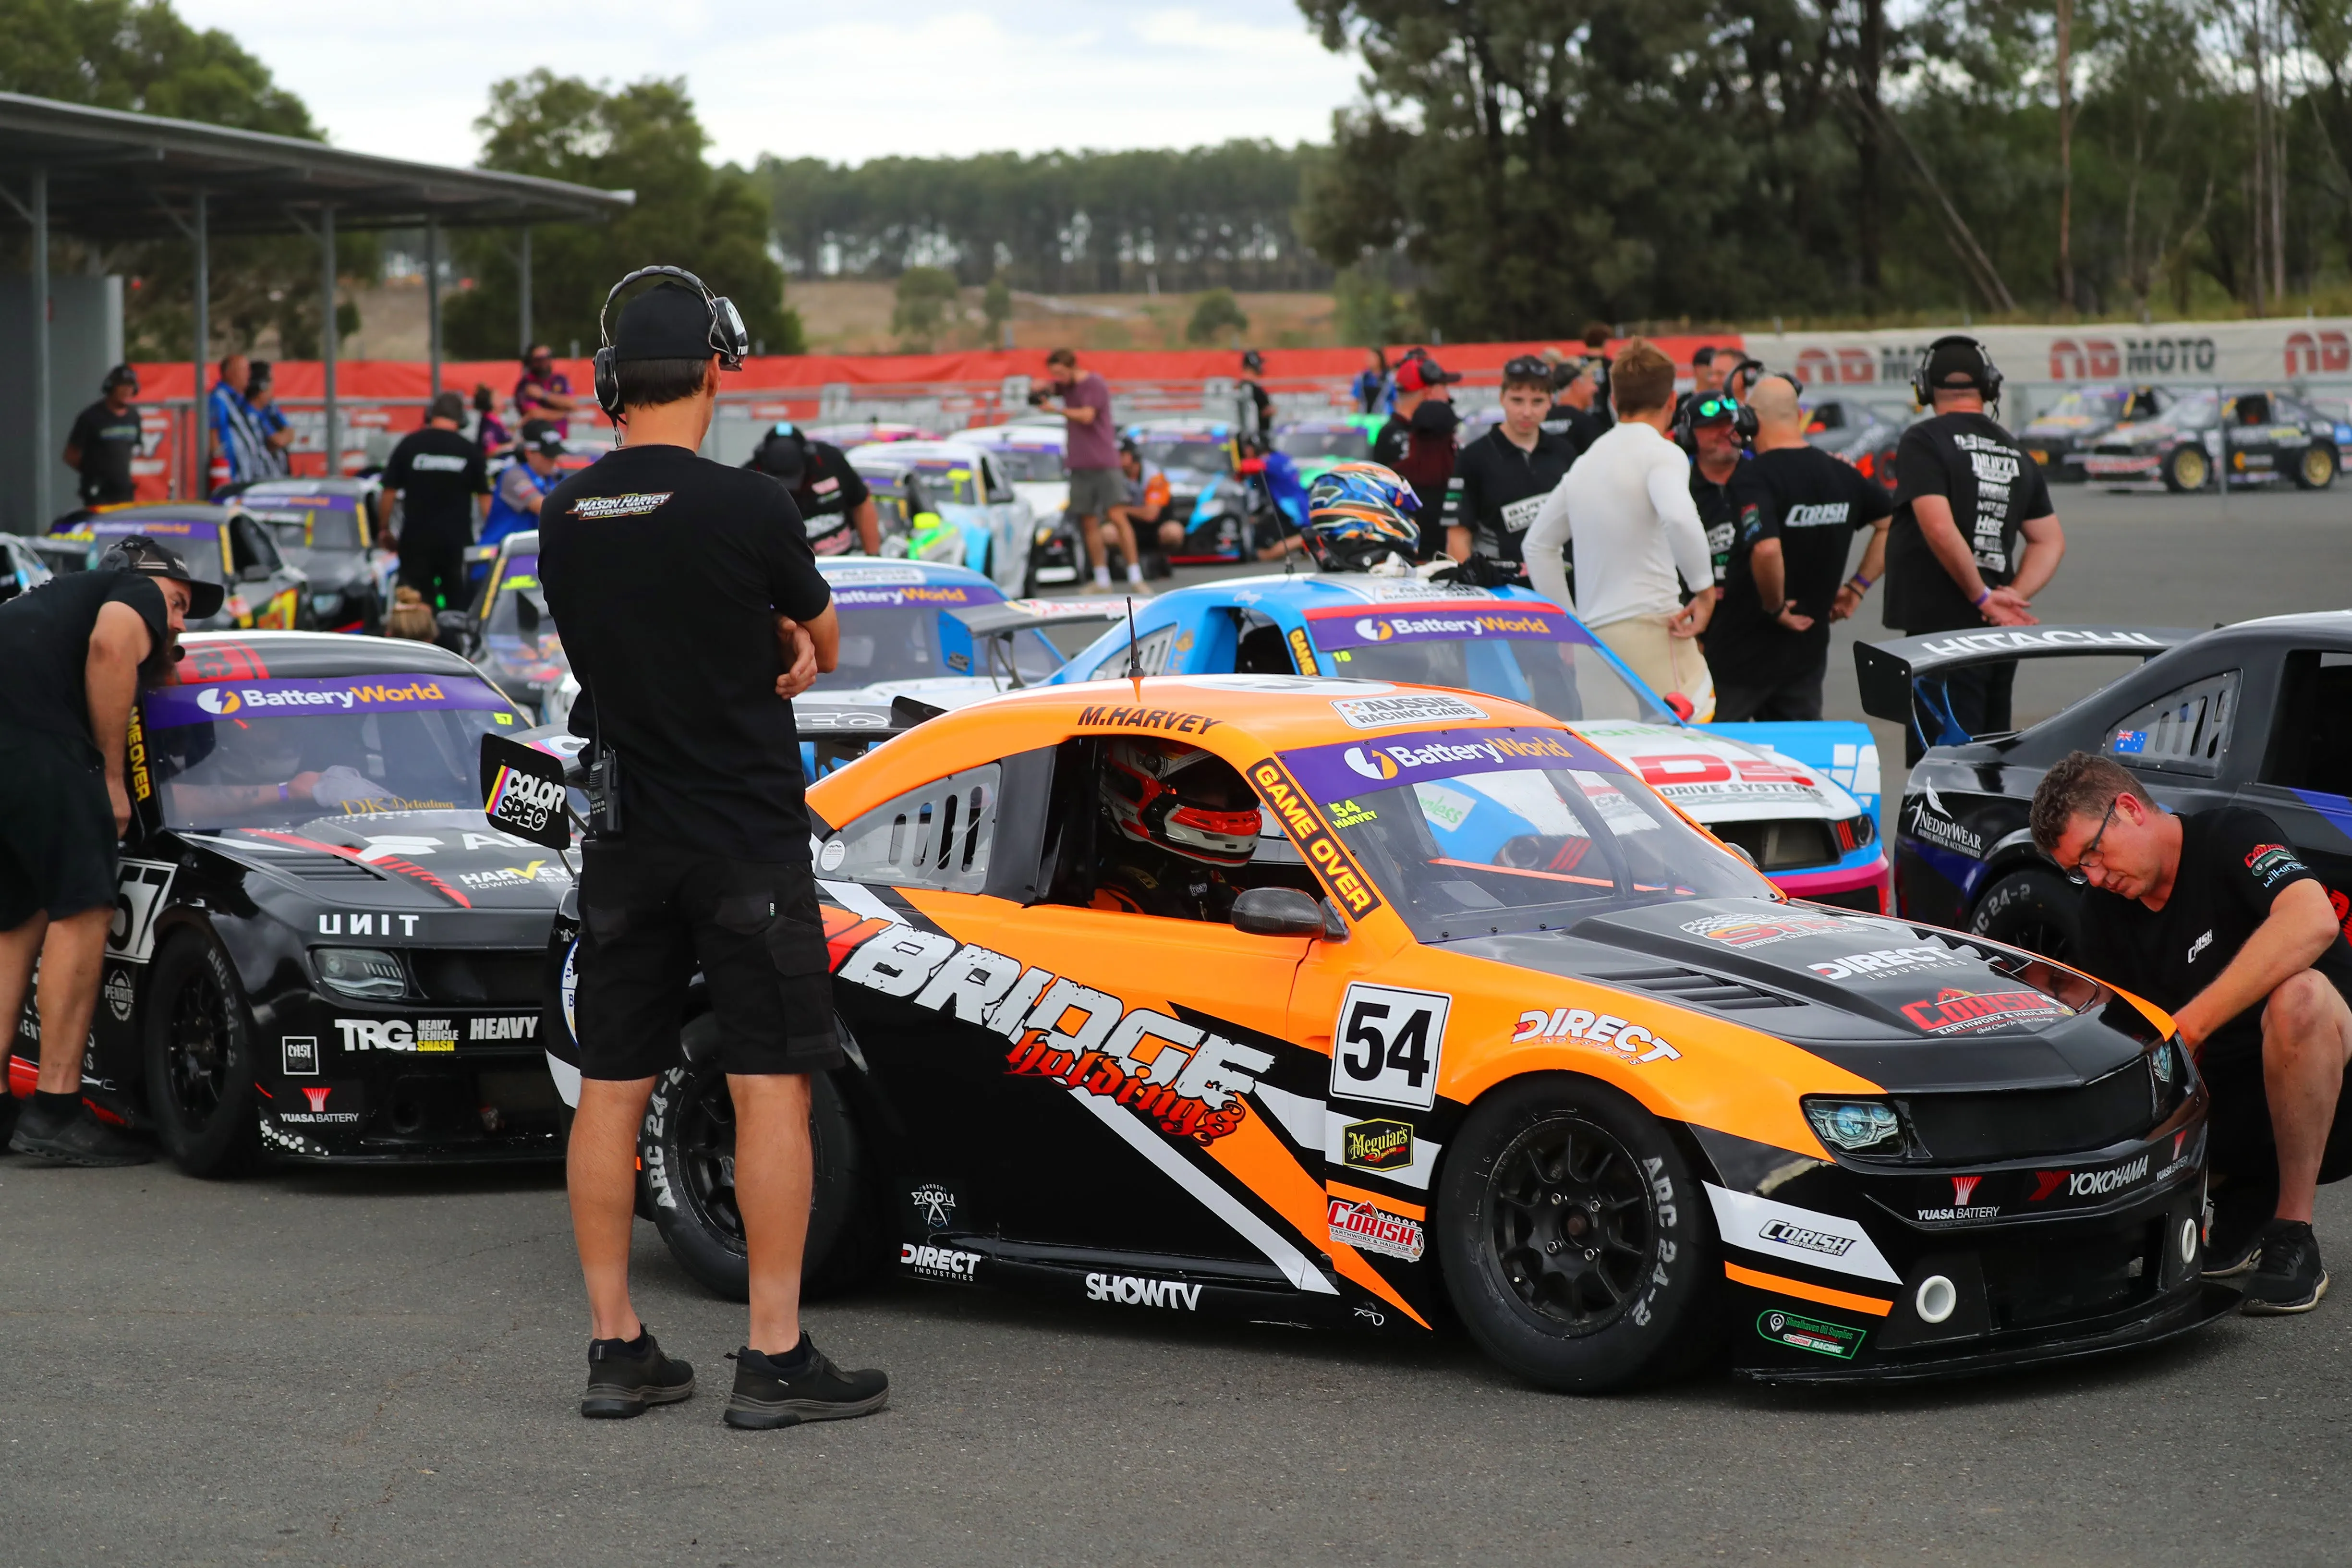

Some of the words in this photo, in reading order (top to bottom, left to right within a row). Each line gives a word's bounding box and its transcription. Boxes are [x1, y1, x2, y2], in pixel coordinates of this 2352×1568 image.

[2126, 337, 2219, 373] MOTO
[574, 498, 620, 511] MASON
[620, 494, 670, 507] HARVEY
[583, 505, 657, 517] MOTORSPORT
[831, 588, 967, 605] atteryWorld
[1922, 632, 2165, 656] HITACHI
[1357, 708, 1429, 724] RACING
[1431, 705, 1477, 719] CARS
[1364, 696, 1460, 714] AUSSIE
[1078, 706, 1223, 735] M.HARVEY
[130, 744, 151, 802] OVER
[505, 769, 566, 813] COLOR
[1662, 785, 1721, 797] DRIVE
[1729, 783, 1824, 798] SYSTEMS
[341, 797, 388, 815] DK
[497, 795, 548, 832] SPEC
[1329, 800, 1362, 818] 54
[1332, 810, 1379, 829] HARVEY
[1255, 764, 1320, 840] GAME
[1310, 837, 1372, 913] OVER
[467, 878, 530, 890] TOWING
[1988, 883, 2031, 916] 24-2
[1738, 936, 1785, 950] STRATEGIC
[1806, 946, 1955, 981] DIRECT
[1866, 960, 1968, 981] INDUSTRIES
[105, 985, 133, 1004] PENRITE
[837, 922, 1276, 1110] BRIDGE
[1900, 992, 2051, 1030] CORISH
[1937, 1015, 2004, 1035] EARTHWORX
[2013, 1009, 2059, 1018] HAULAGE
[417, 1020, 451, 1031] HEAVY
[417, 1030, 459, 1041] VEHICLE
[470, 1016, 539, 1041] HEAVY
[1511, 1008, 1683, 1063] DIRECT
[417, 1040, 455, 1052] SMASH
[1343, 1001, 1432, 1088] 54
[1534, 1036, 1641, 1065] INDUSTRIES
[645, 1068, 685, 1137] 24-2
[280, 1113, 315, 1123] YUASA
[315, 1113, 360, 1123] BATTERY
[1348, 1127, 1409, 1162] Meguiar's
[644, 1146, 677, 1208] ARC
[2068, 1155, 2150, 1196] YOKOHAMA
[2156, 1166, 2172, 1182] YUASA
[1641, 1156, 1678, 1229] ARC
[1328, 1202, 1417, 1246] CORISH
[1917, 1208, 1955, 1220] YUASA
[1956, 1206, 2000, 1219] BATTERY
[1331, 1228, 1370, 1242] EARTHWORX
[1380, 1240, 1410, 1252] HAULAGE
[1759, 1219, 1854, 1252] CORISH
[1785, 1238, 1845, 1256] MOTORSPORTS
[900, 1243, 982, 1275] DIRECT
[914, 1266, 974, 1282] INDUSTRIES
[1632, 1239, 1678, 1327] 24-2
[1085, 1272, 1203, 1312] SHOWTV
[1785, 1316, 1819, 1332] Shoalhaven
[1819, 1325, 1828, 1335] Oil
[1828, 1326, 1854, 1340] Supplies
[1789, 1335, 1810, 1347] Castrol
[1811, 1340, 1845, 1354] RACING
